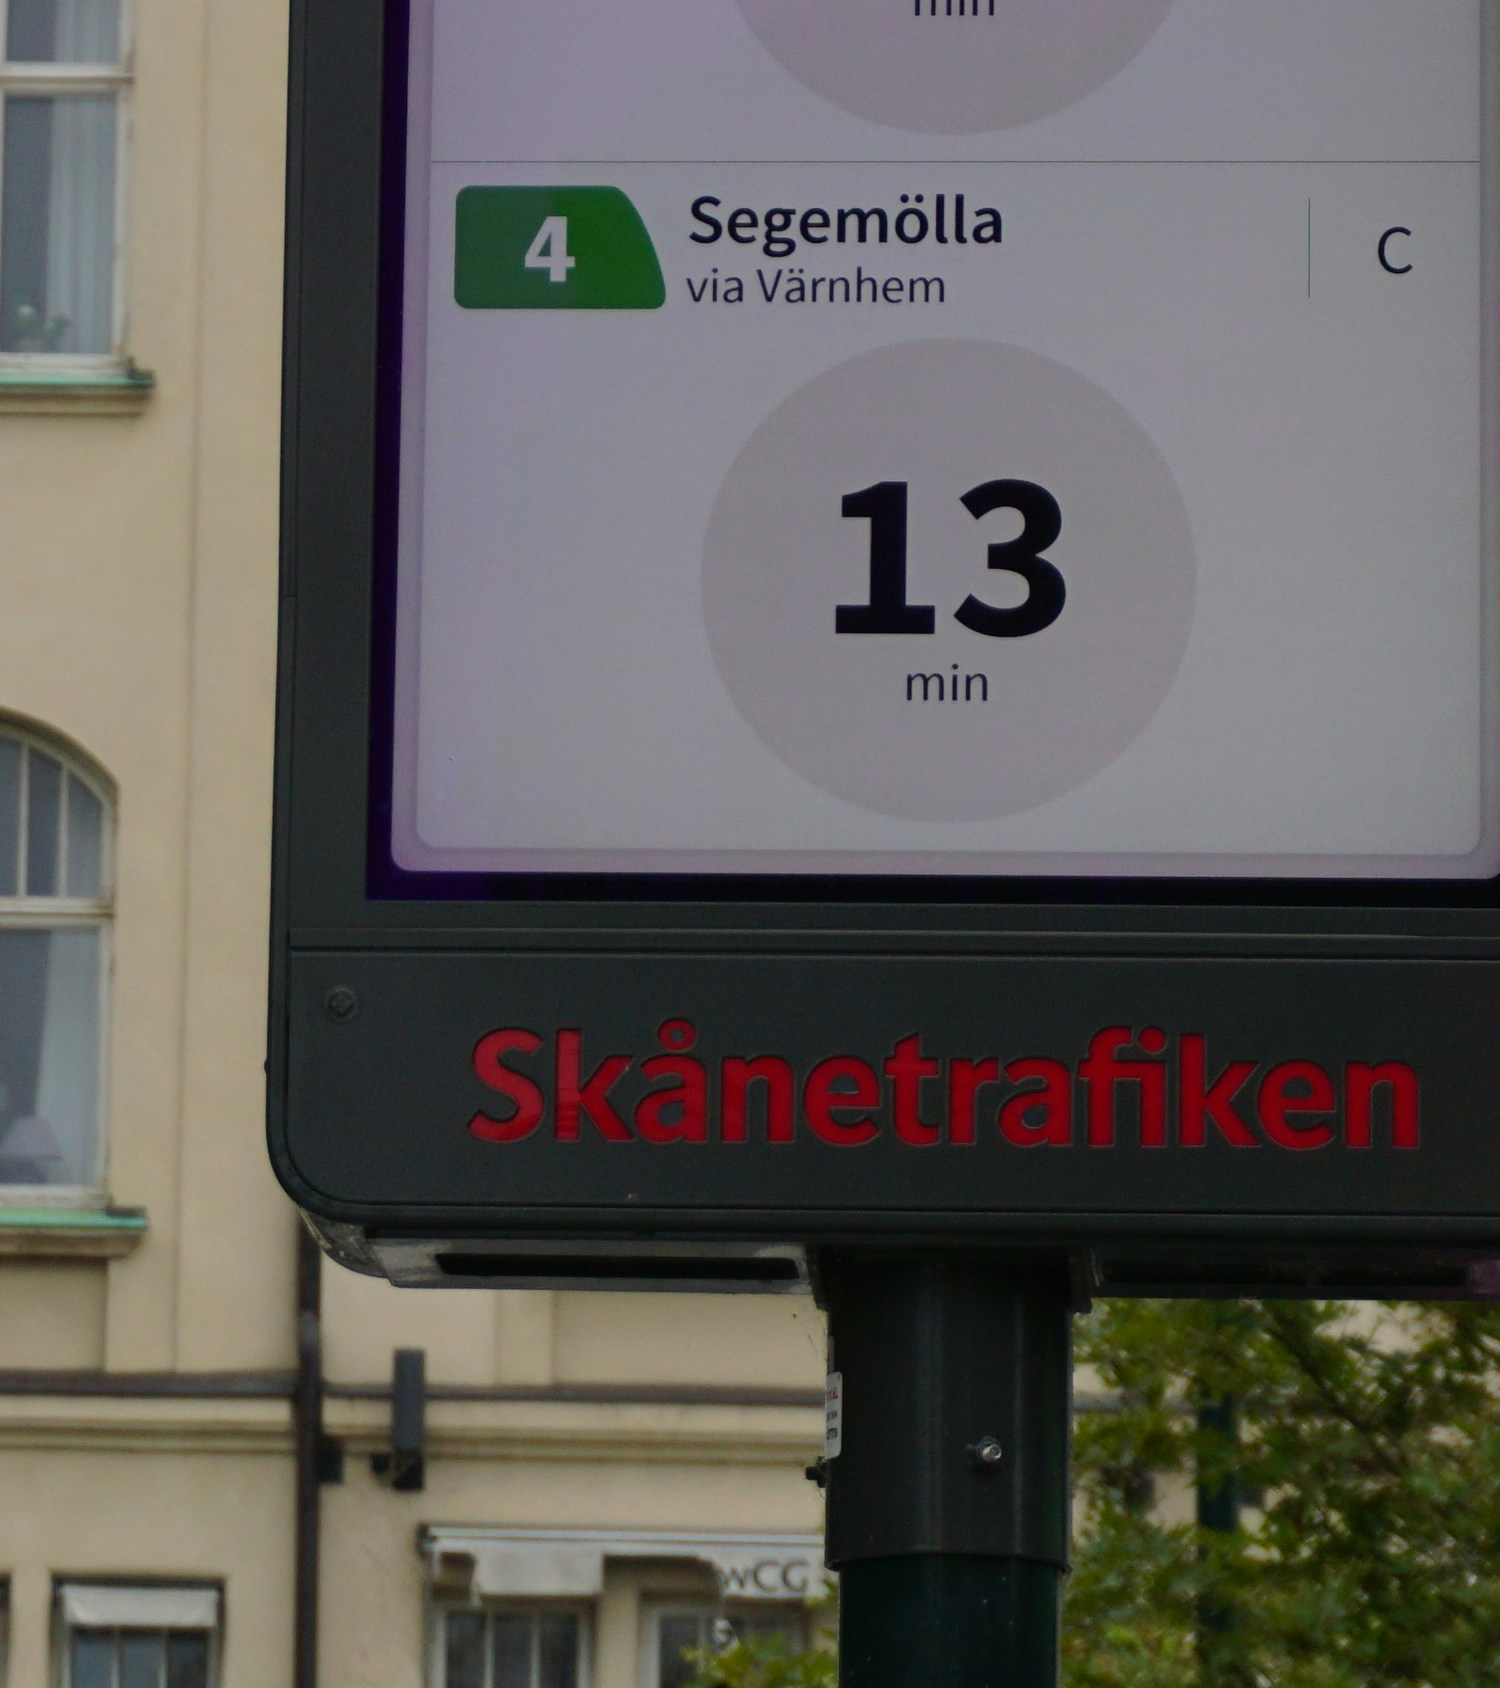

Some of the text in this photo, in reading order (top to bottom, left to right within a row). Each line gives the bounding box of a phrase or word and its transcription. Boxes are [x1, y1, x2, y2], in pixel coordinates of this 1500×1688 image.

[524, 215, 576, 283] 4
[689, 193, 1002, 258] Segemölla
[1377, 226, 1413, 275] C
[686, 266, 945, 304] via Värnhem
[835, 478, 1067, 638] 13
[906, 663, 988, 702] min
[470, 1020, 1418, 1150] Skånetrafiken
